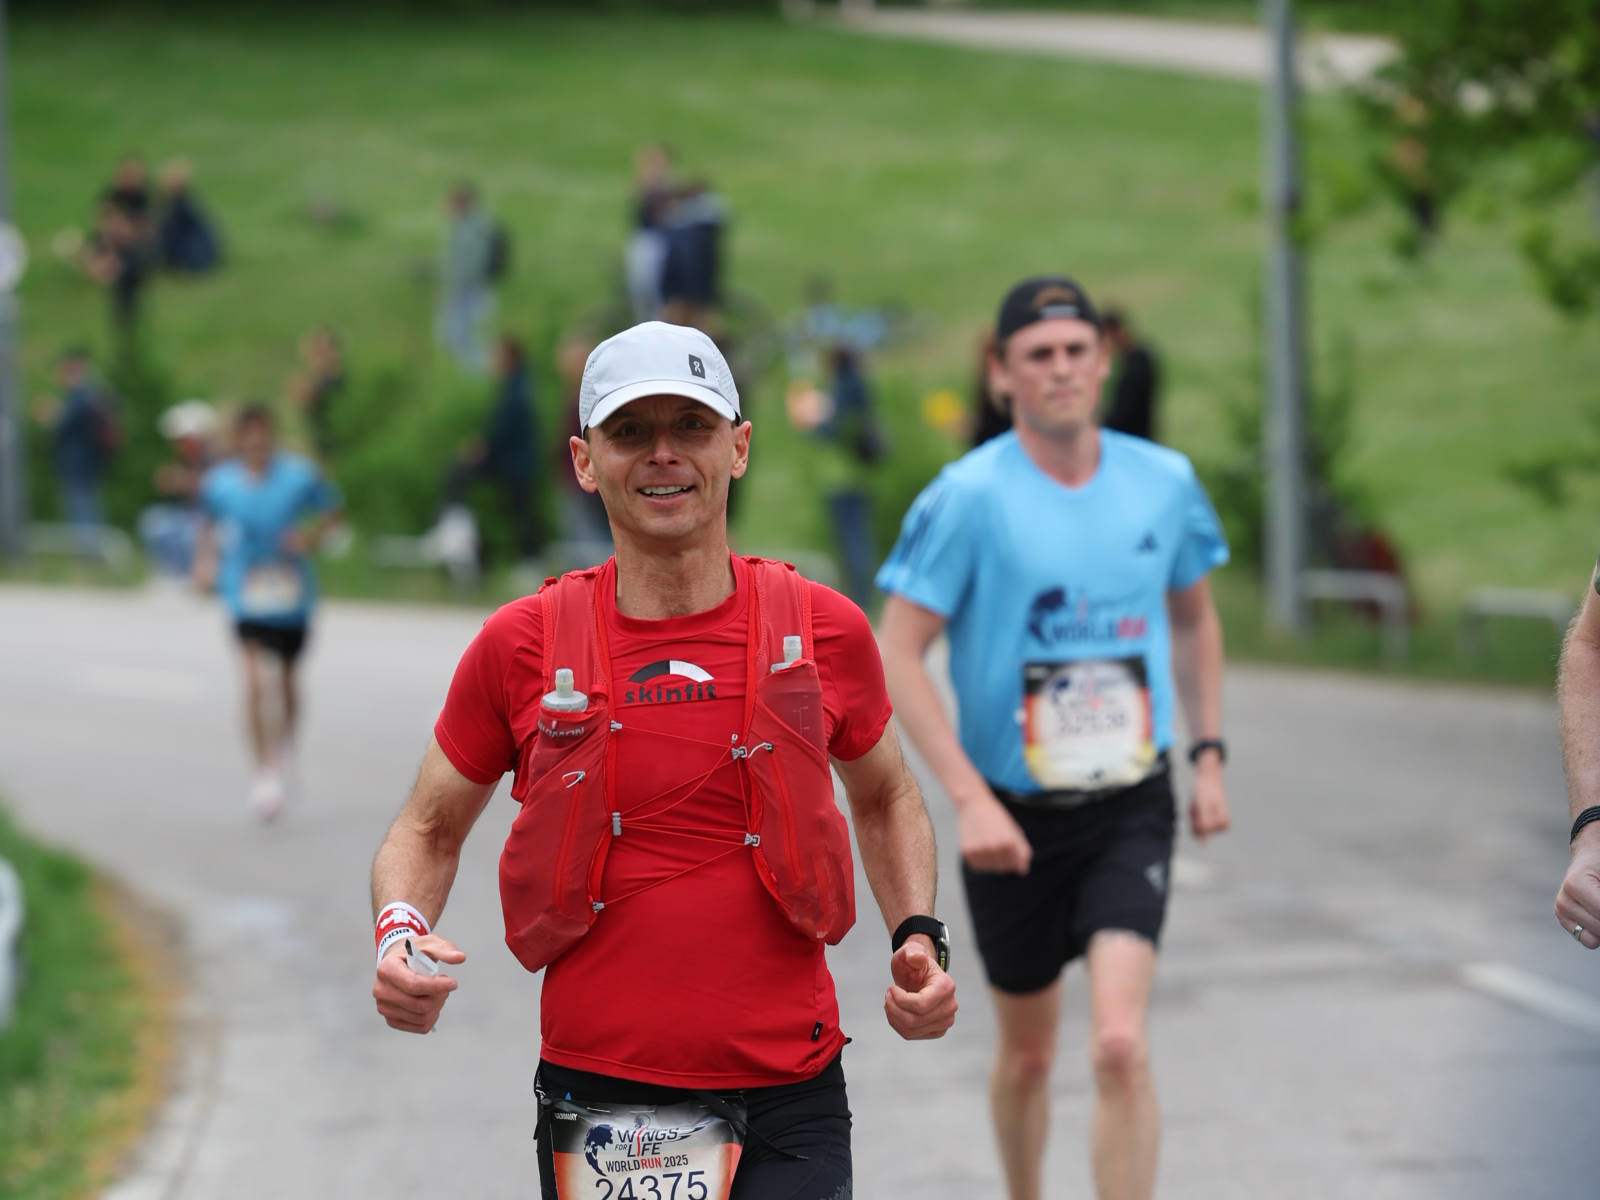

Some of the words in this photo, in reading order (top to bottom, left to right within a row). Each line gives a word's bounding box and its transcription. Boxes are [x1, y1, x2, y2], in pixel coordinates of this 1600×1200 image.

[624, 682, 717, 705] skinfit
[617, 1127, 679, 1143] WINGS
[627, 1141, 662, 1158] LIFE
[664, 1154, 689, 1168] 2025
